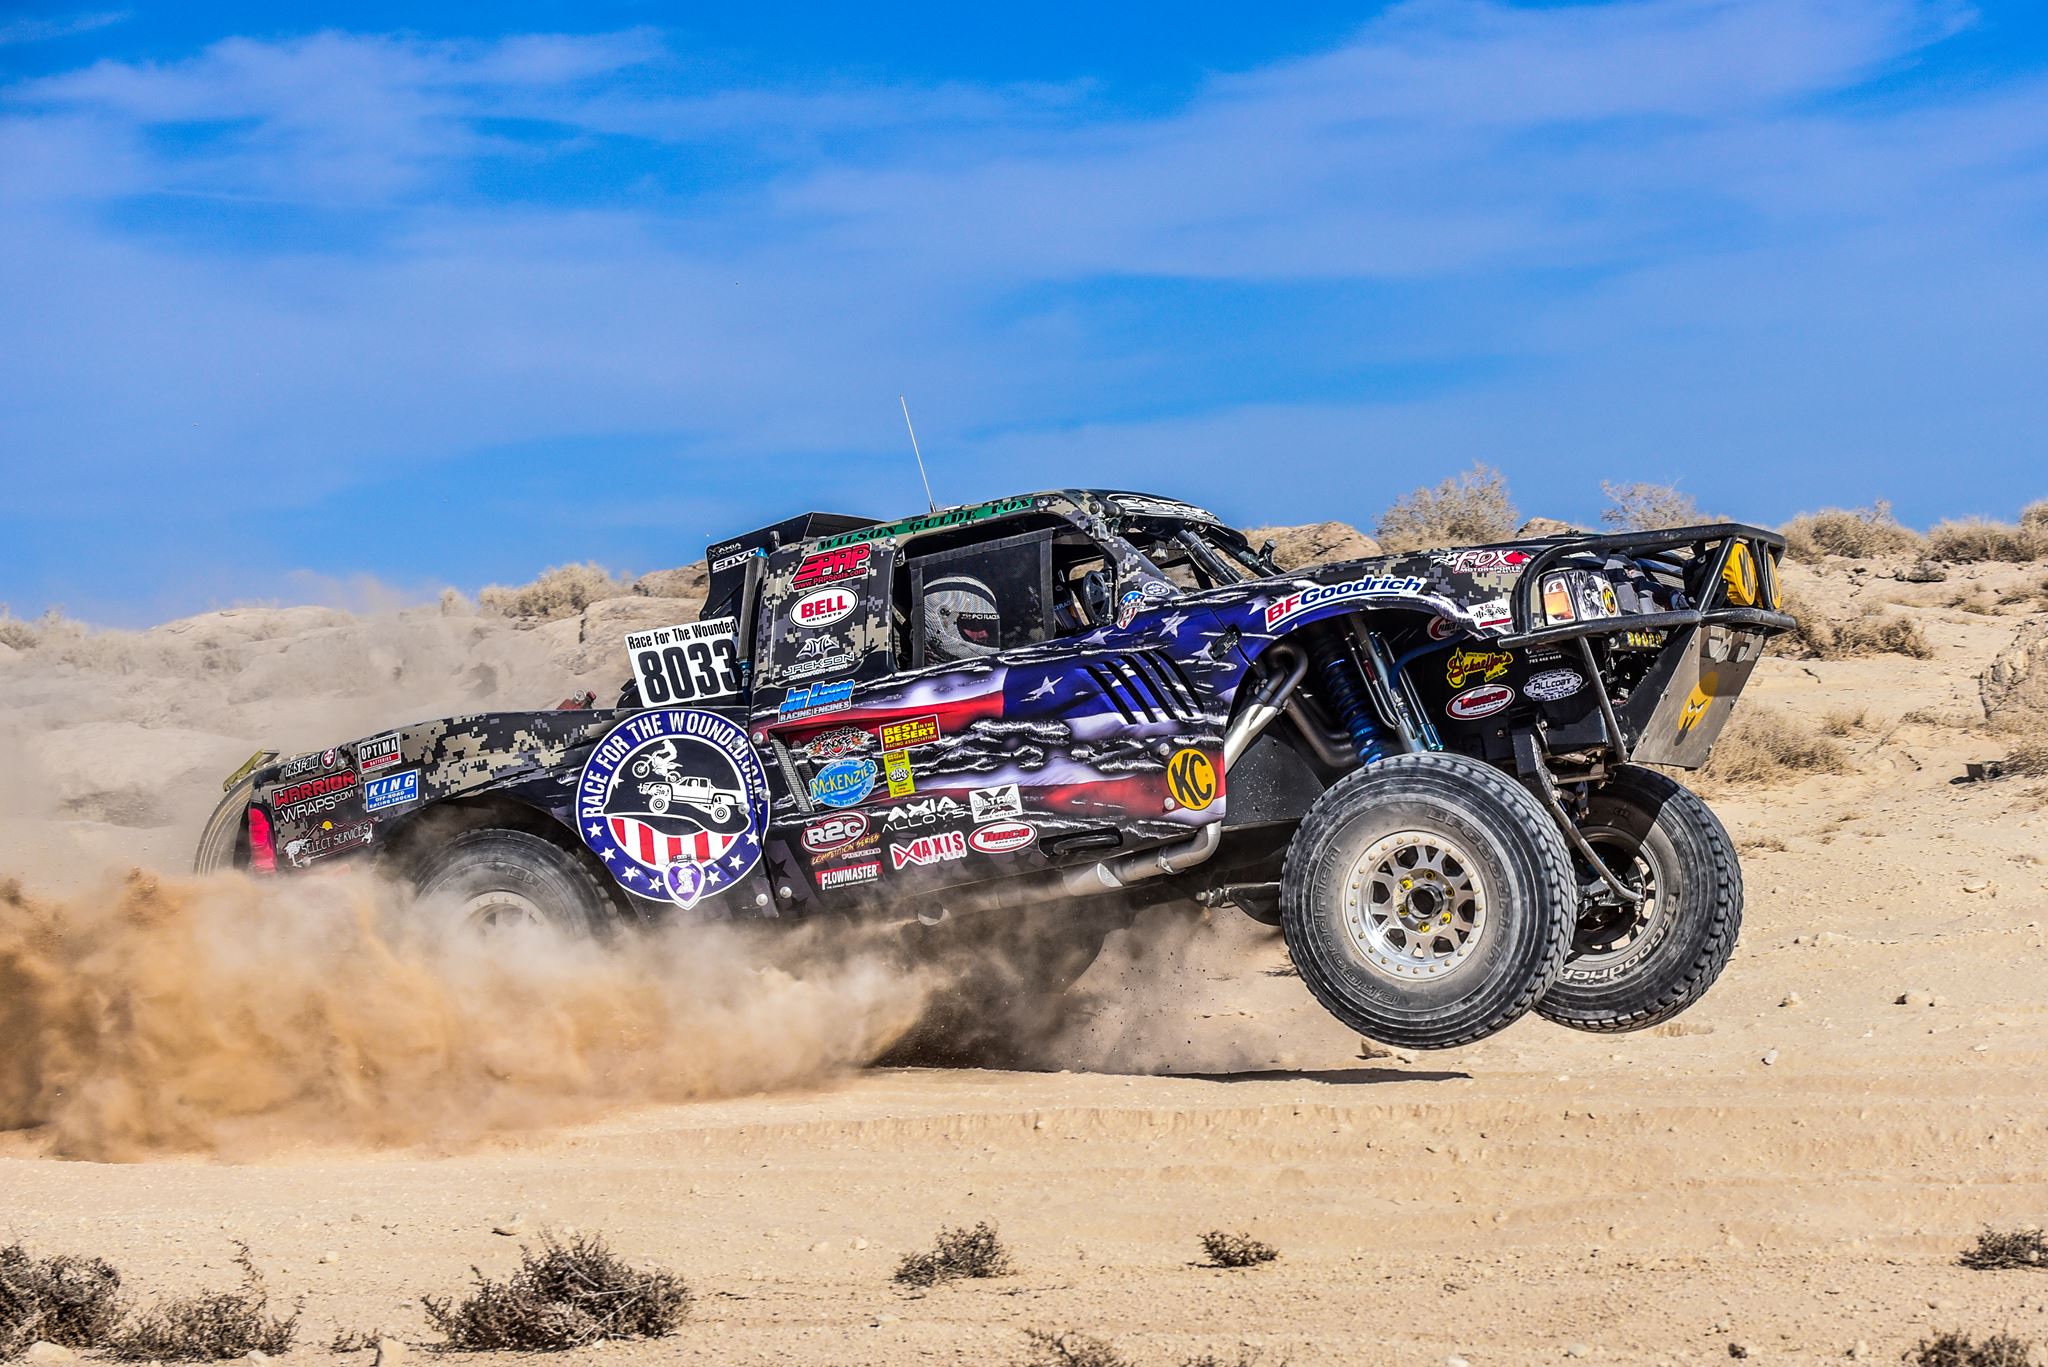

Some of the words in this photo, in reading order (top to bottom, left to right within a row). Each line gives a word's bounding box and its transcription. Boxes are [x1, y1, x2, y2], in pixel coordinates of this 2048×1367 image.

[819, 525, 897, 550] WILSON
[991, 498, 1032, 515] FOX
[801, 595, 848, 618] BELL
[1267, 576, 1422, 624] BFGoodrich
[806, 611, 842, 622] HELMETS
[628, 635, 653, 649] Race
[653, 631, 670, 645] For
[672, 627, 692, 641] The
[691, 618, 739, 638] Wounded
[638, 639, 740, 703] 8033
[782, 652, 855, 677] JACKSON
[1533, 678, 1572, 691] ALLCOAT
[780, 710, 812, 721] RACING
[813, 701, 850, 715] ENGINES
[883, 722, 919, 736] BEST
[884, 727, 935, 744] DESERT
[361, 739, 397, 760] OPTIMA
[885, 741, 904, 749] RACING
[905, 735, 937, 744] ASSOCIATION
[582, 771, 608, 818] RACE
[595, 734, 631, 771] FOR
[626, 714, 663, 743] THE
[274, 771, 355, 808] WARRIOR
[369, 775, 415, 797] KING
[1171, 752, 1212, 806] KC
[887, 796, 957, 822] AXIA
[973, 794, 1015, 808] ULTRA
[882, 807, 965, 833] ALLOYS
[301, 837, 331, 856] SELECT
[333, 823, 369, 846] SERVICES
[806, 821, 862, 845] R2C
[921, 833, 964, 858] AXIS
[811, 844, 855, 865] COMPETITION
[856, 833, 880, 849] SERIES
[821, 864, 878, 891] FLOWMASTER
